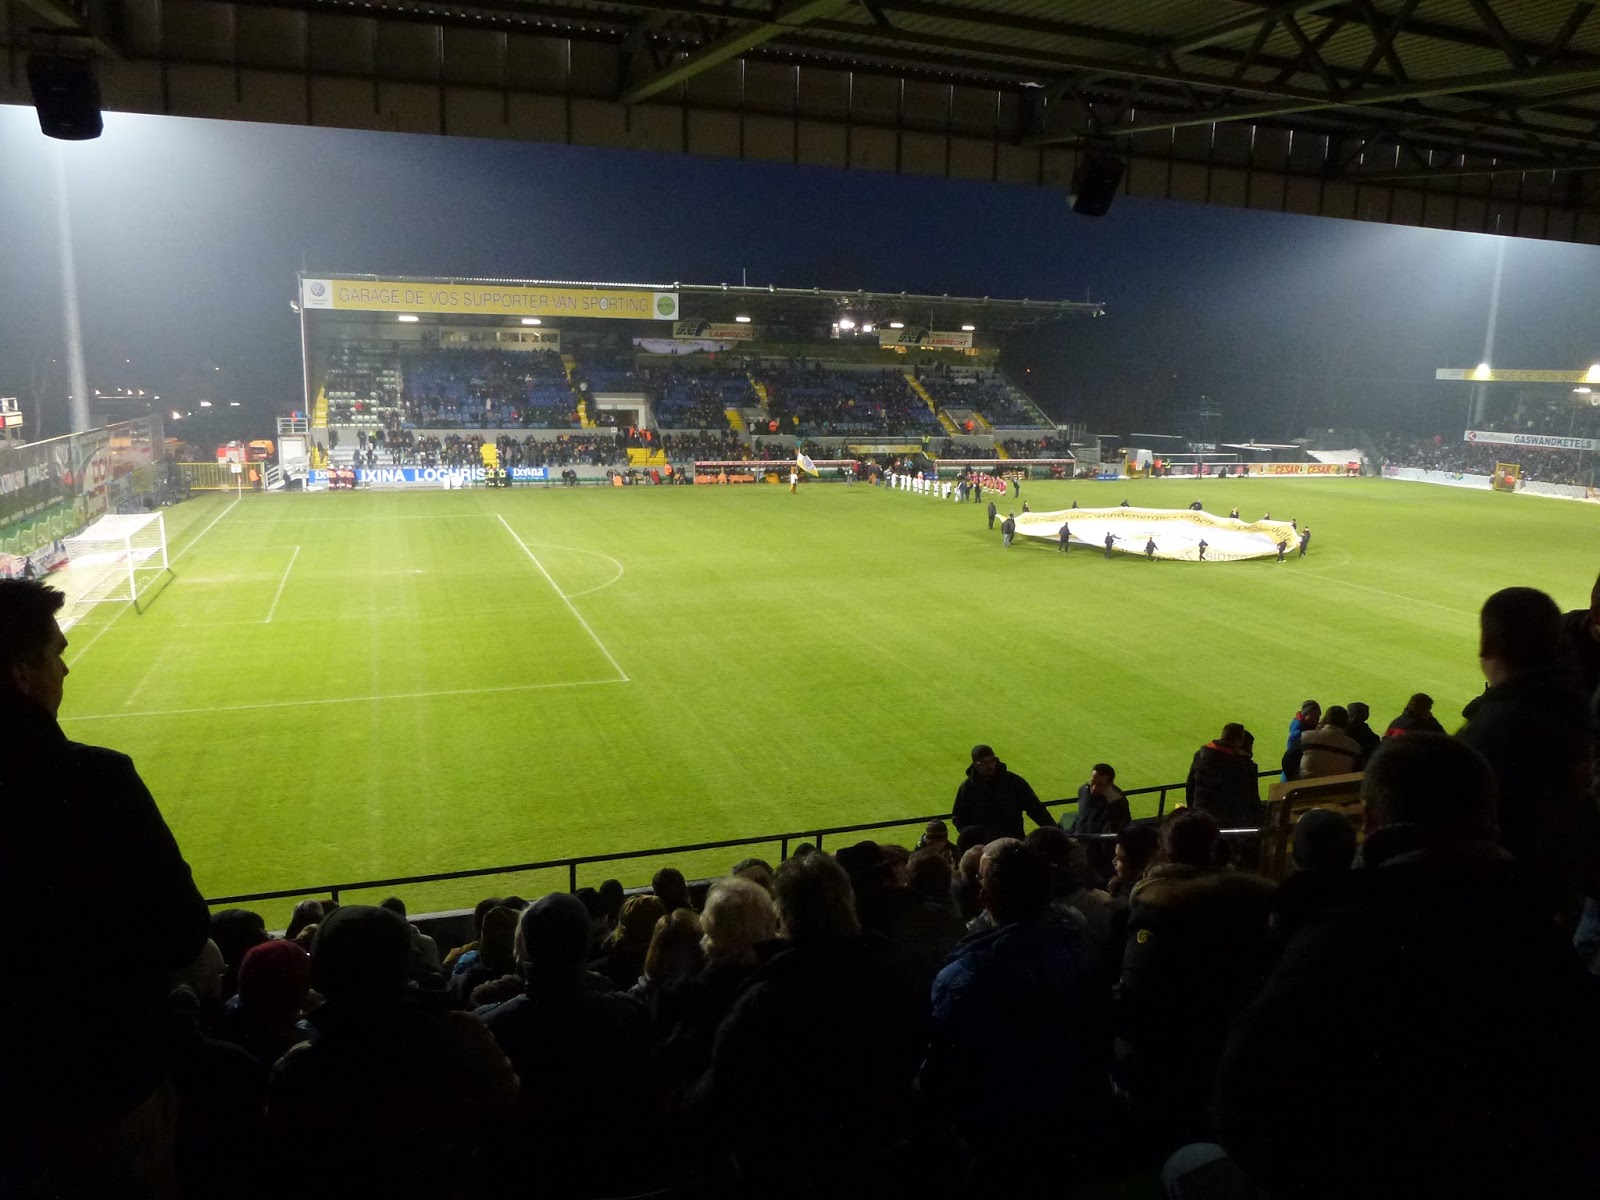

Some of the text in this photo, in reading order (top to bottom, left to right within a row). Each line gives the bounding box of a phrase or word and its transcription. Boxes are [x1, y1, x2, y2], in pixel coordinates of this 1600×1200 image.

[339, 287, 649, 312] GARAGE DE VOS SUPPORTER VAN SPORTING
[927, 338, 968, 346] LAMBRECHT
[1513, 435, 1592, 448] GASWANDKETELS
[361, 468, 487, 482] IXINA LOCHRIS
